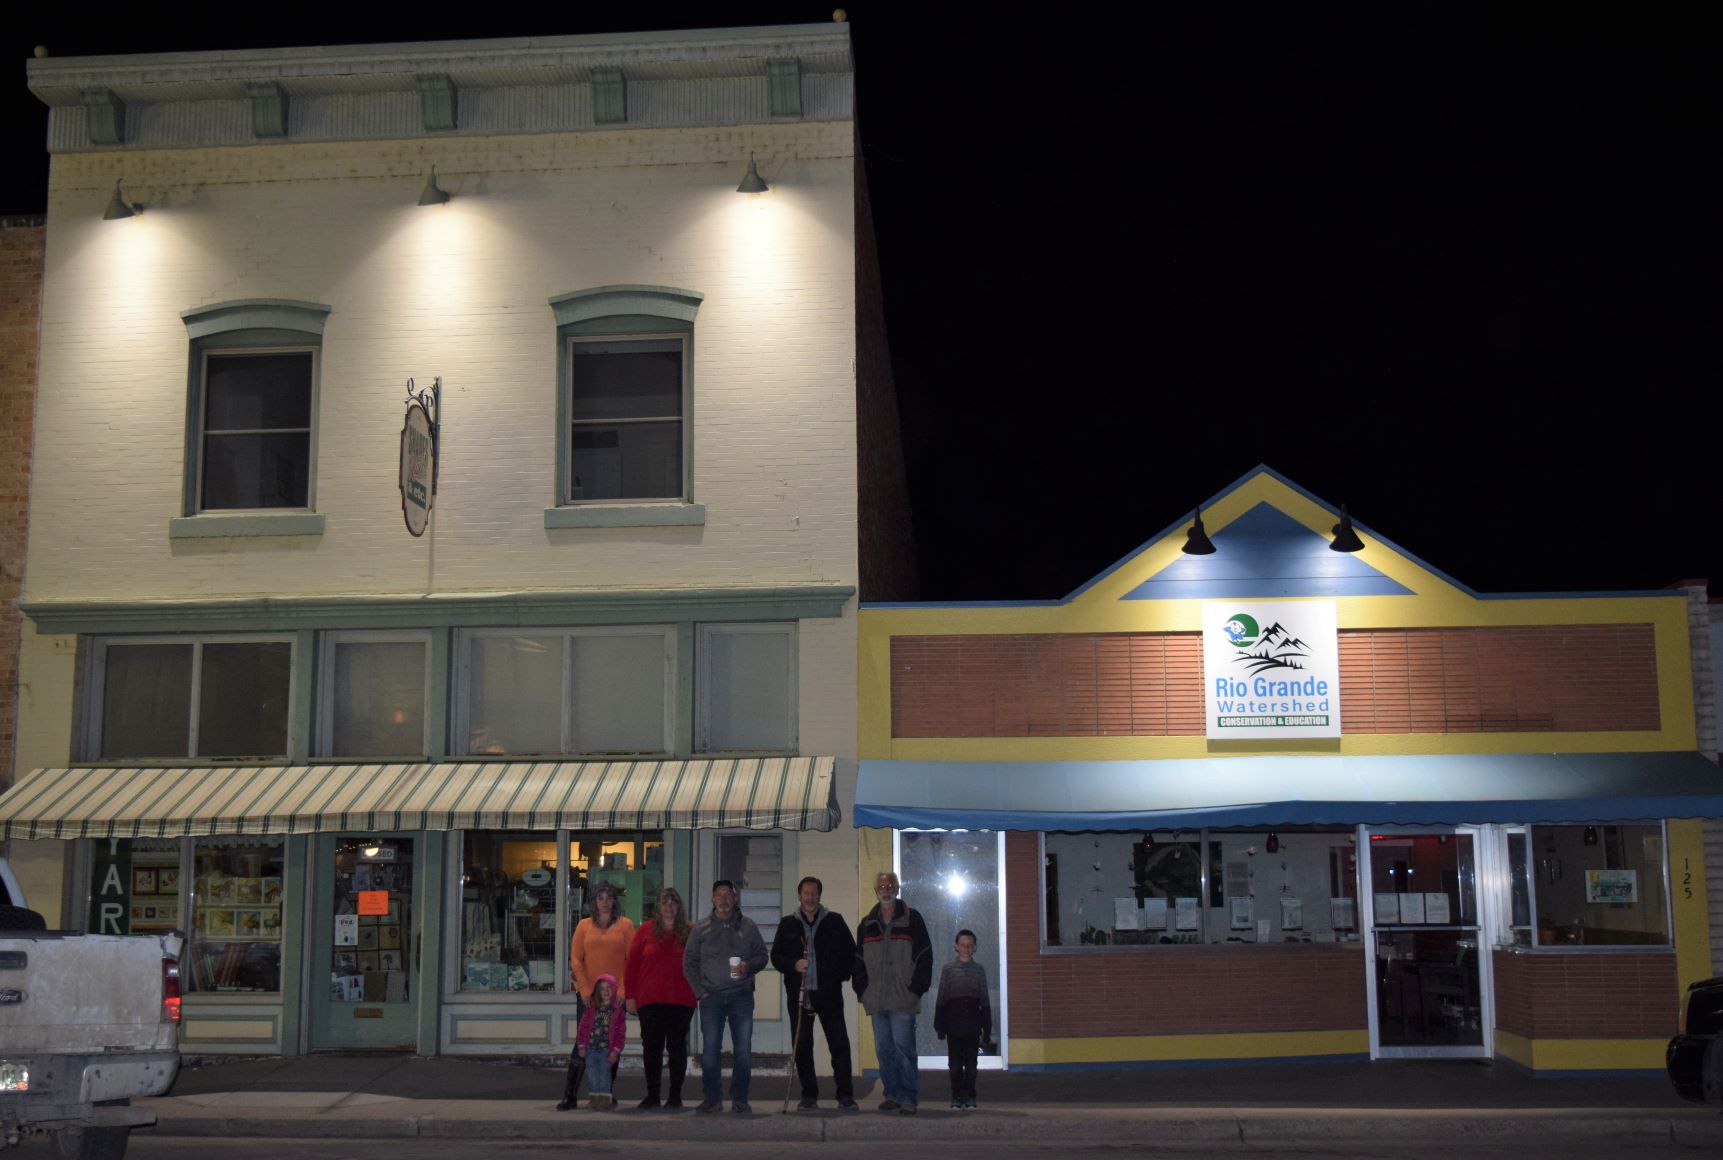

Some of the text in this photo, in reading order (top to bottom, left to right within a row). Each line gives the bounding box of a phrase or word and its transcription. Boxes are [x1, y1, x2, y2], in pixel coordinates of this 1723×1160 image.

[1215, 675, 1328, 698] Rio Grande
[1217, 698, 1329, 713] Watershed
[1220, 715, 1327, 726] CONSERVATION & EDUCATION
[1683, 857, 1693, 900] 125
